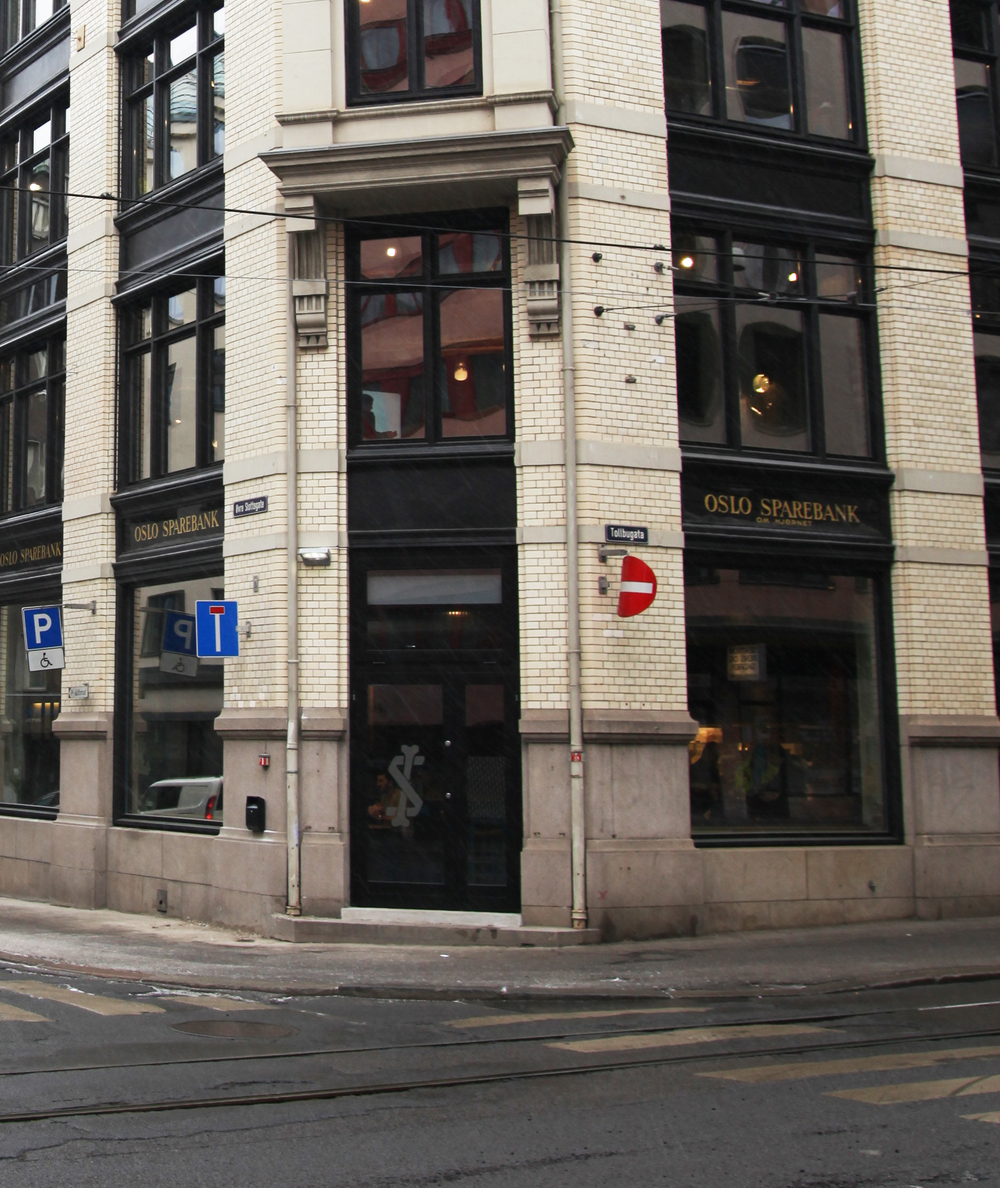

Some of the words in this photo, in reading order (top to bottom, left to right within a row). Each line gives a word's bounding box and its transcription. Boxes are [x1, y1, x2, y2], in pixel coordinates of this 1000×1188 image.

[704, 494, 752, 515] OSLO
[761, 498, 861, 523] SPAREBANK
[134, 523, 159, 542] OSLO
[162, 510, 219, 537] SPAREBANK
[610, 527, 645, 541] Tollbugata
[0, 550, 18, 567] OSLO
[20, 541, 62, 562] SPAREBANK
[33, 613, 52, 644] P
